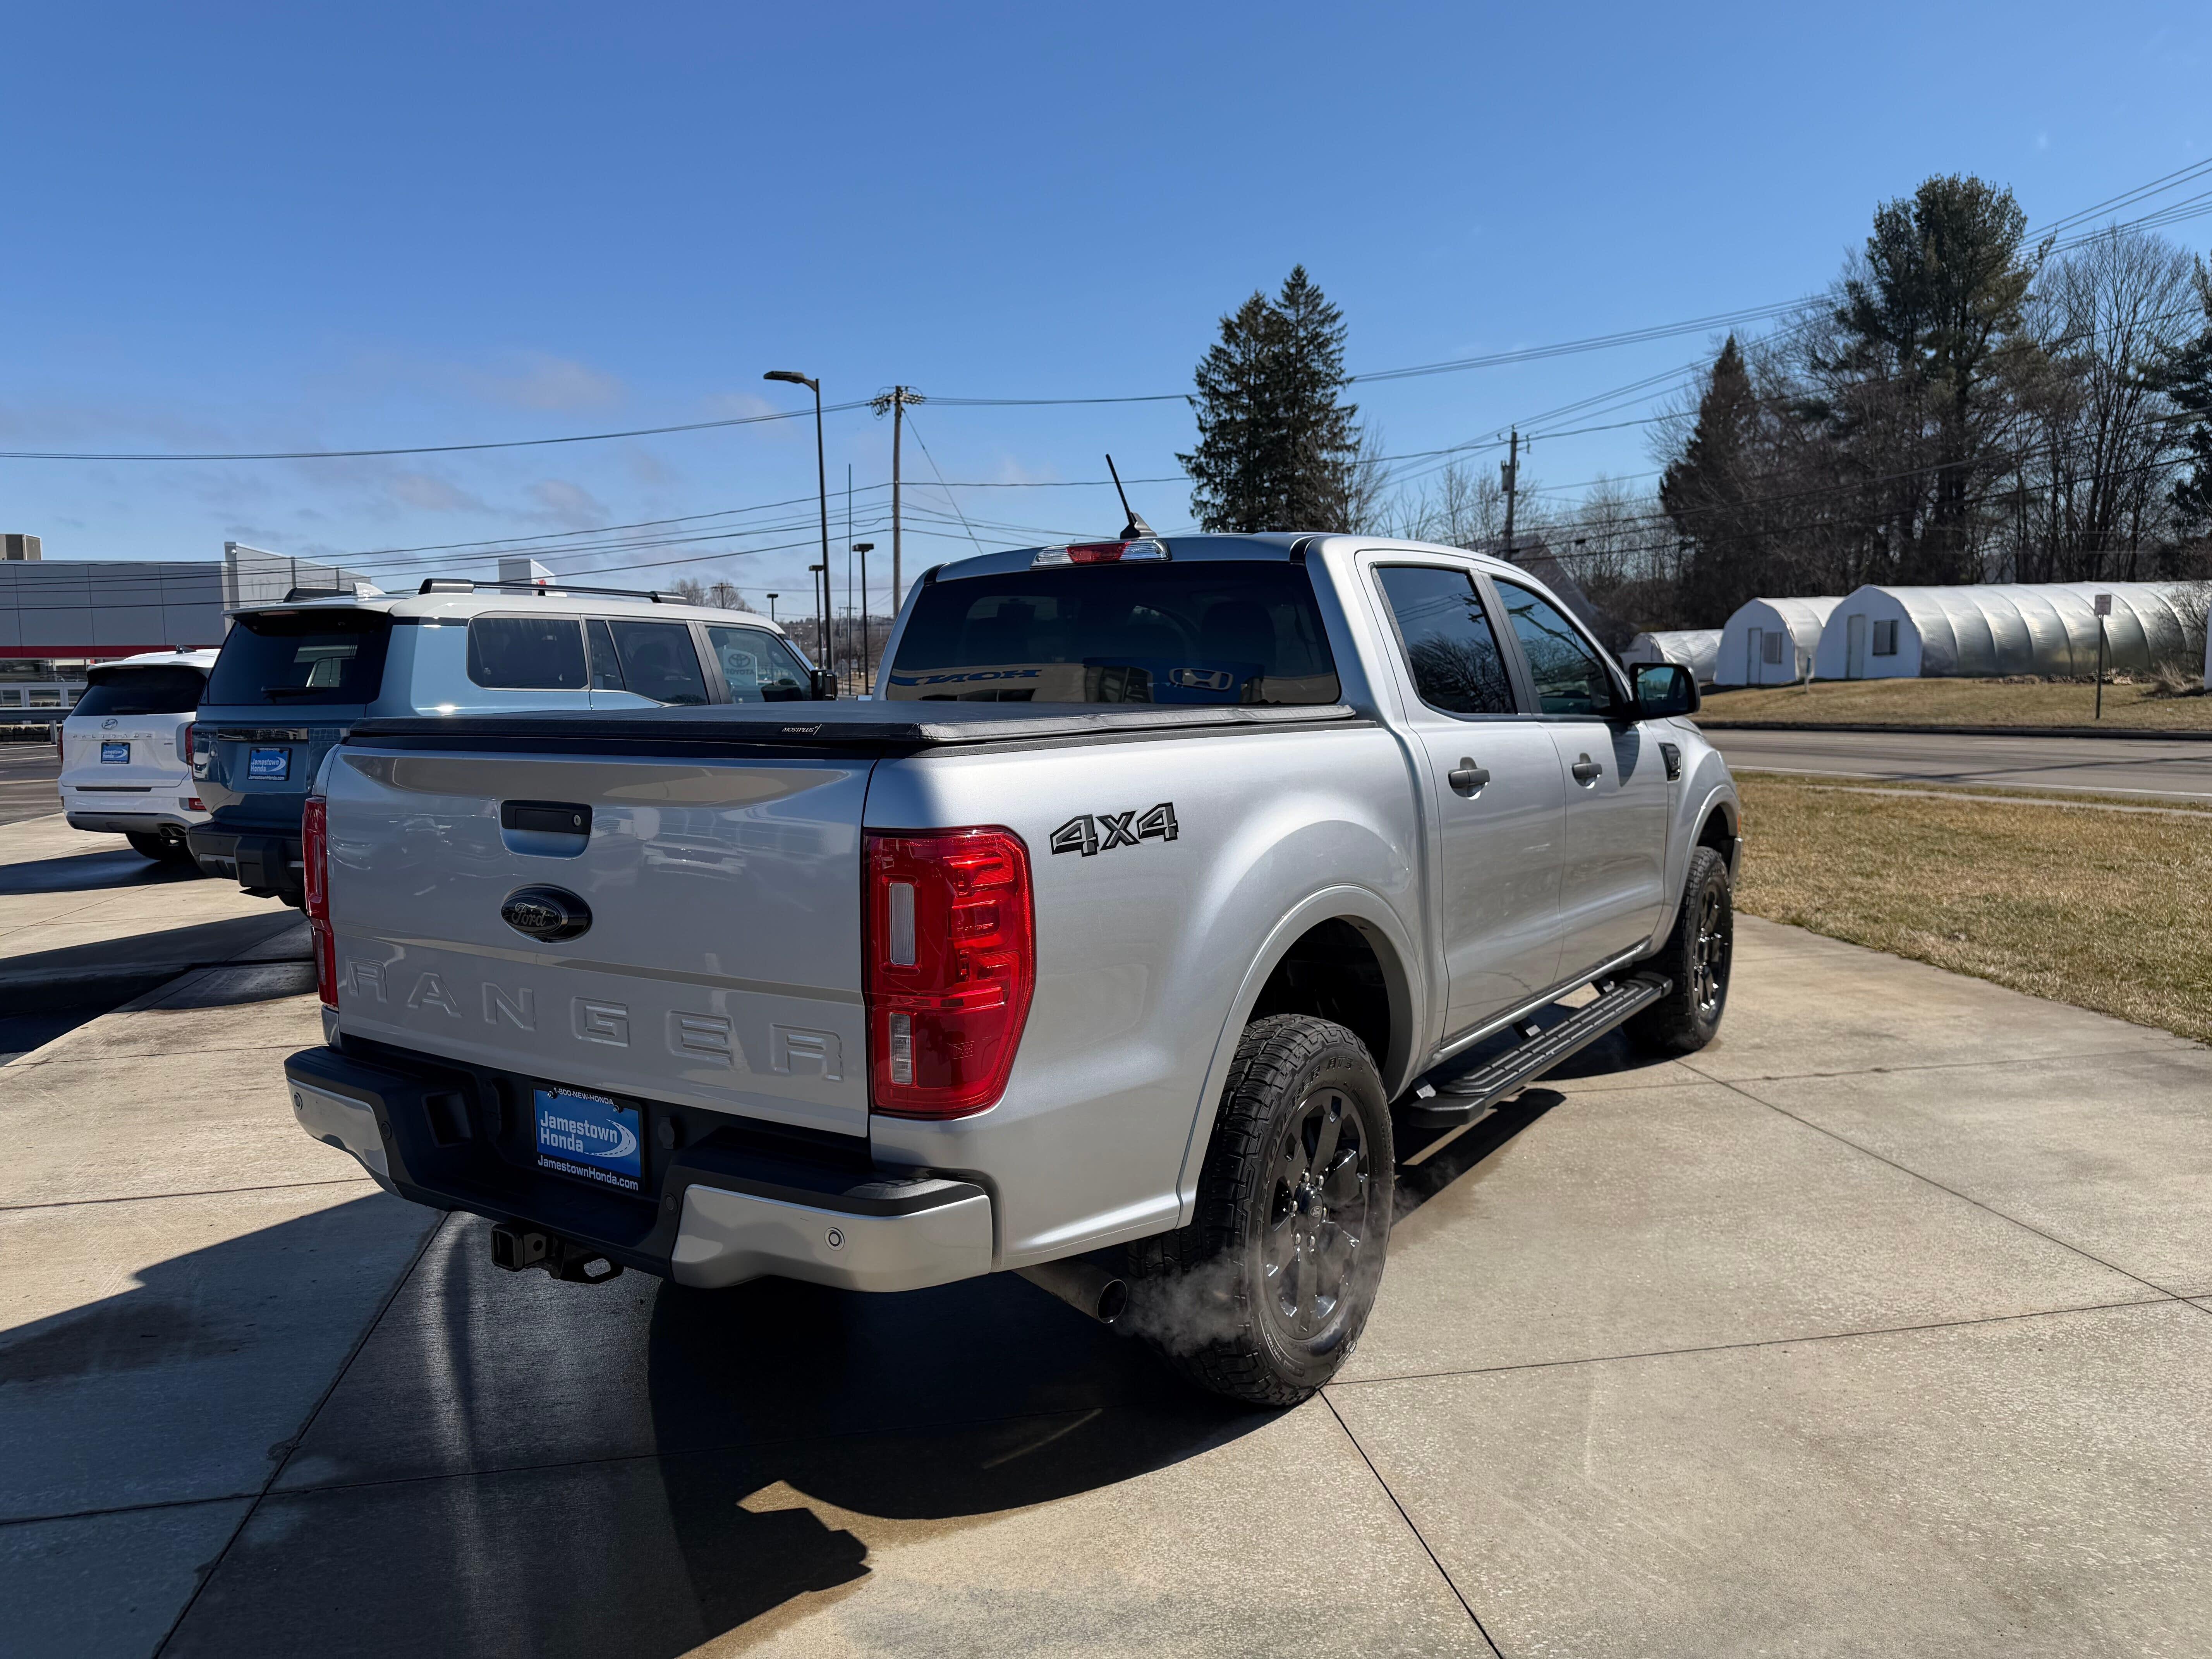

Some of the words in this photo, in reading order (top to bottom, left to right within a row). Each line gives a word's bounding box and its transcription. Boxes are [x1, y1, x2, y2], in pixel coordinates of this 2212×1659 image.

[511, 902, 546, 927] Ford
[345, 955, 844, 1082] RANGER
[553, 1087, 614, 1106] 1-800-NEW-HONDA
[540, 1111, 618, 1143] Jamestown
[541, 1127, 584, 1153] Honda
[538, 1155, 638, 1191] JamestownHonda.com
